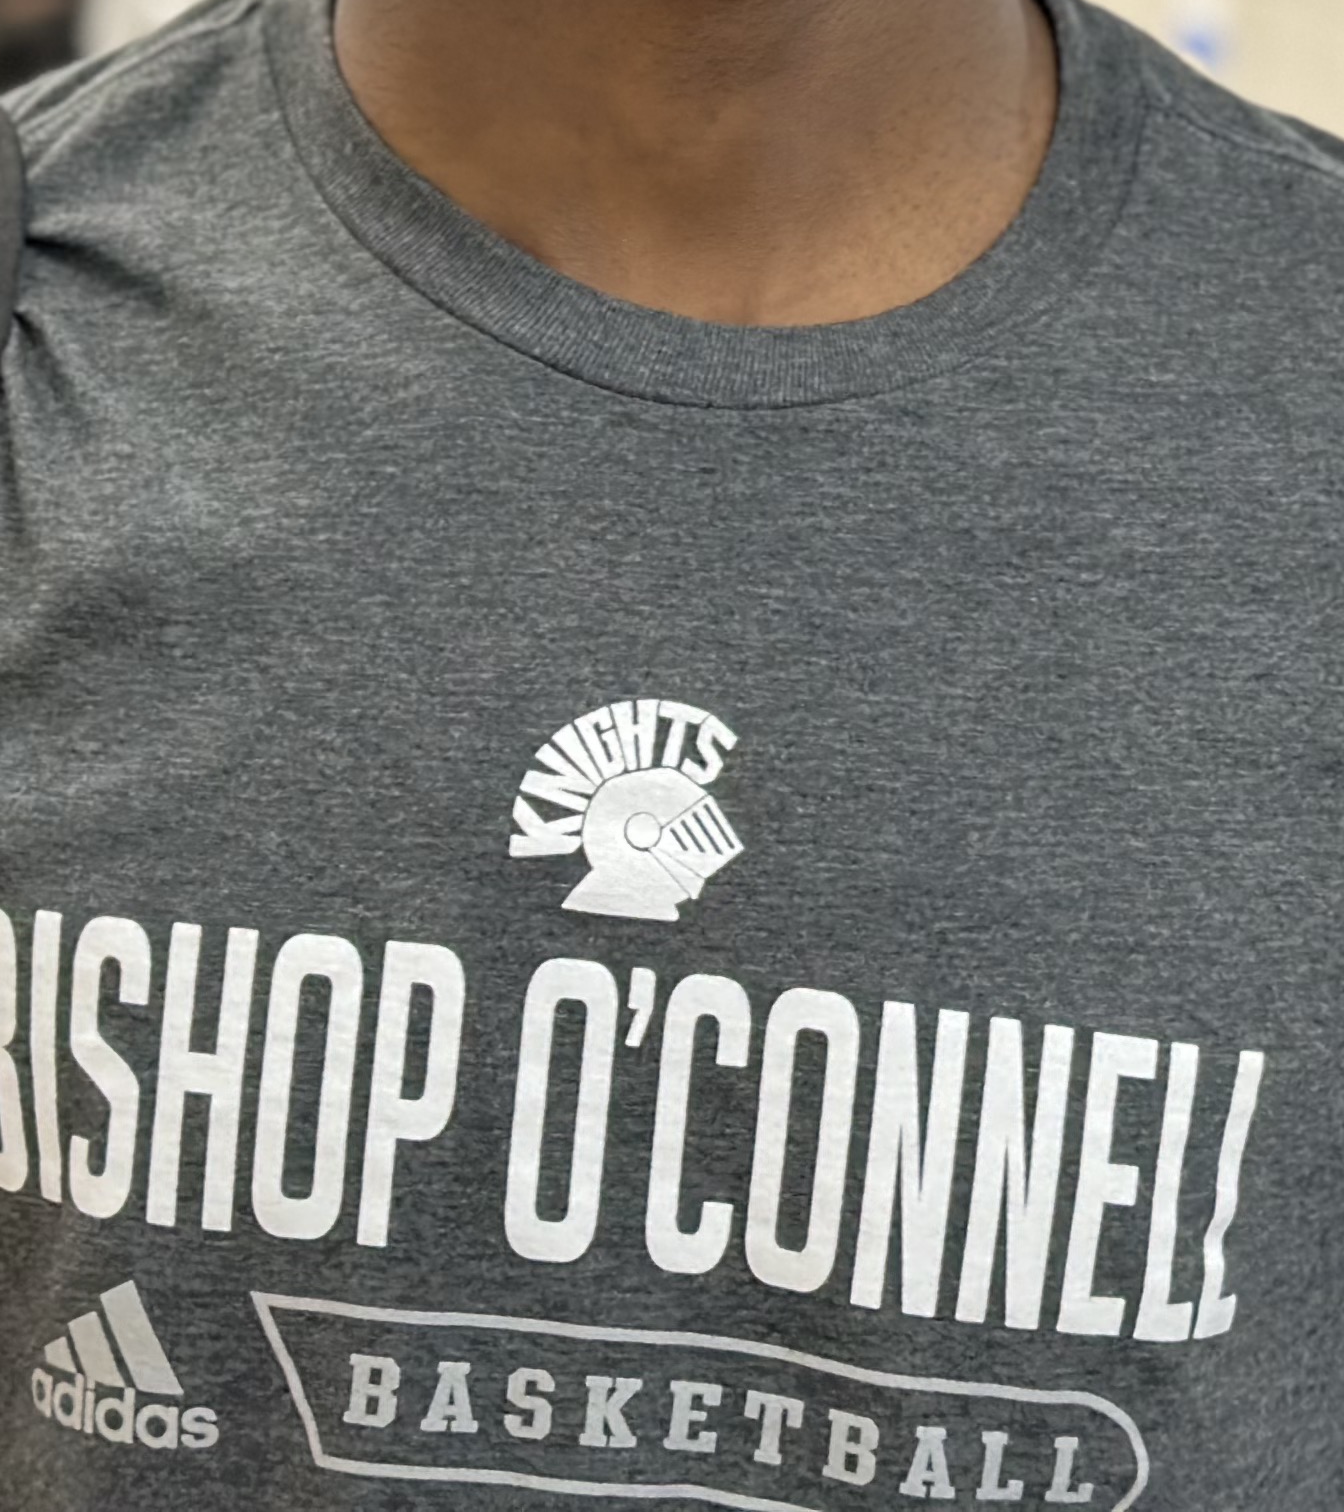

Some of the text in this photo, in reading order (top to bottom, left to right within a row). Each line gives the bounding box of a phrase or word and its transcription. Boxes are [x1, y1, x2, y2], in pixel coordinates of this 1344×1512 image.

[508, 699, 737, 857] KNIGHTS
[504, 959, 1265, 1343] O'CONNELL
[31, 1368, 219, 1449] adidas
[343, 1354, 1095, 1504] BASKETBALL
